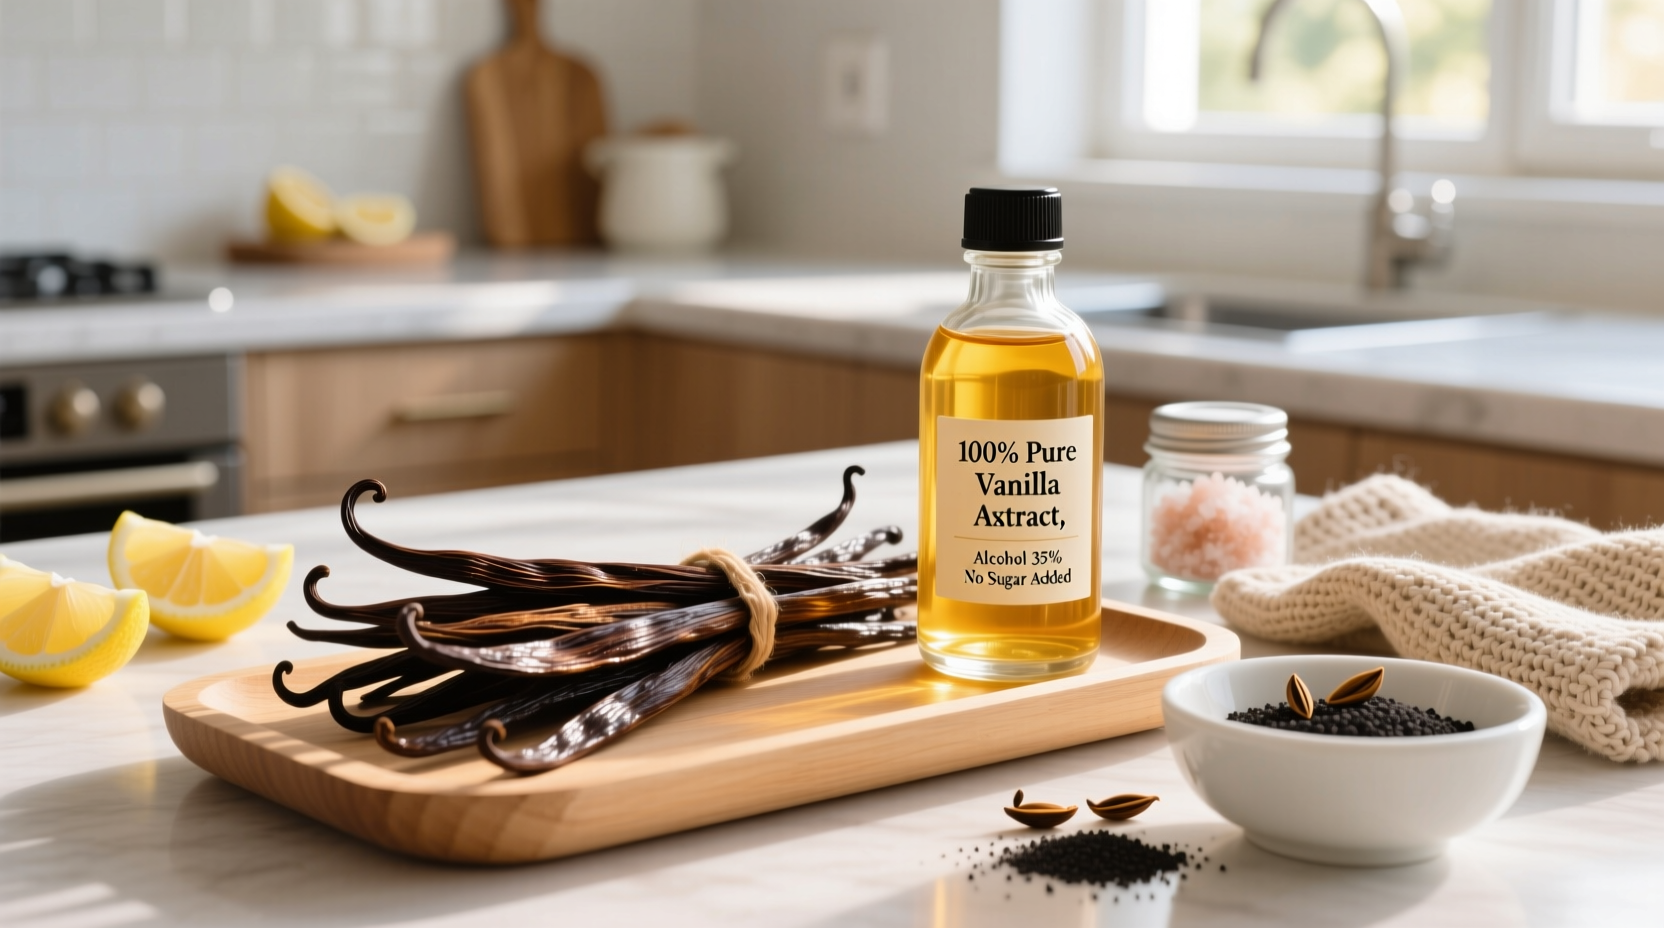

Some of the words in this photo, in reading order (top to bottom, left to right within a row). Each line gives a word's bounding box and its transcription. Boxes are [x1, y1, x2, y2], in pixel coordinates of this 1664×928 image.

[958, 440, 1019, 463] 100%
[1026, 441, 1077, 463] Pure
[975, 470, 1061, 496] Vanilla
[973, 504, 1066, 530] Axtract,
[973, 550, 1027, 565] Alcohol
[1031, 549, 1063, 565] 35%
[964, 569, 984, 584] No
[987, 571, 1027, 590] Sugar
[1030, 568, 1072, 585] Added
